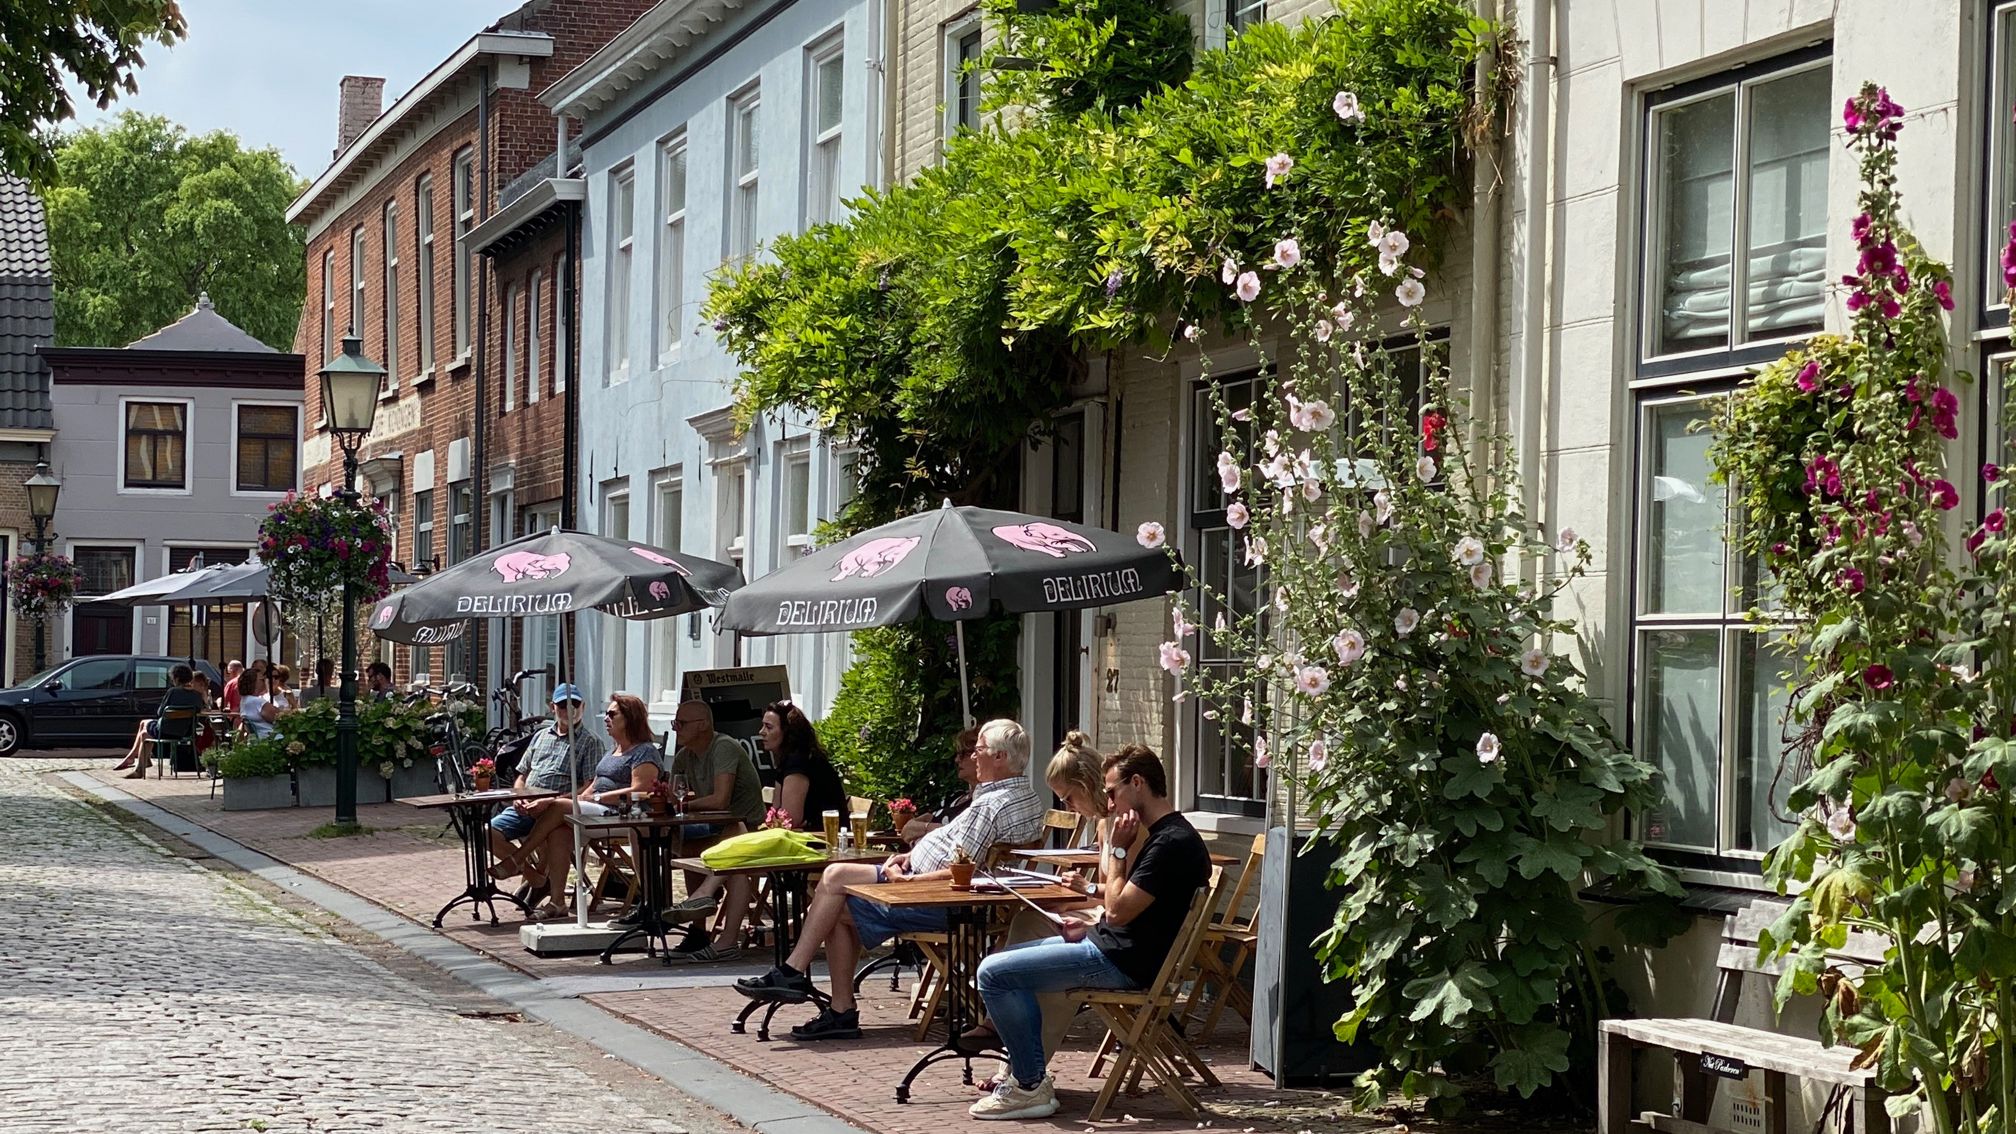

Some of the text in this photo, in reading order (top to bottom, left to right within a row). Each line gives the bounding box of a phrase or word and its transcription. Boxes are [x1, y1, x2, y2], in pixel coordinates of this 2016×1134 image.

[1043, 568, 1143, 603] DELIRIUM
[456, 592, 573, 613] DELIRIUM
[776, 597, 878, 625] DELIRIUM
[706, 670, 755, 684] Westmalle
